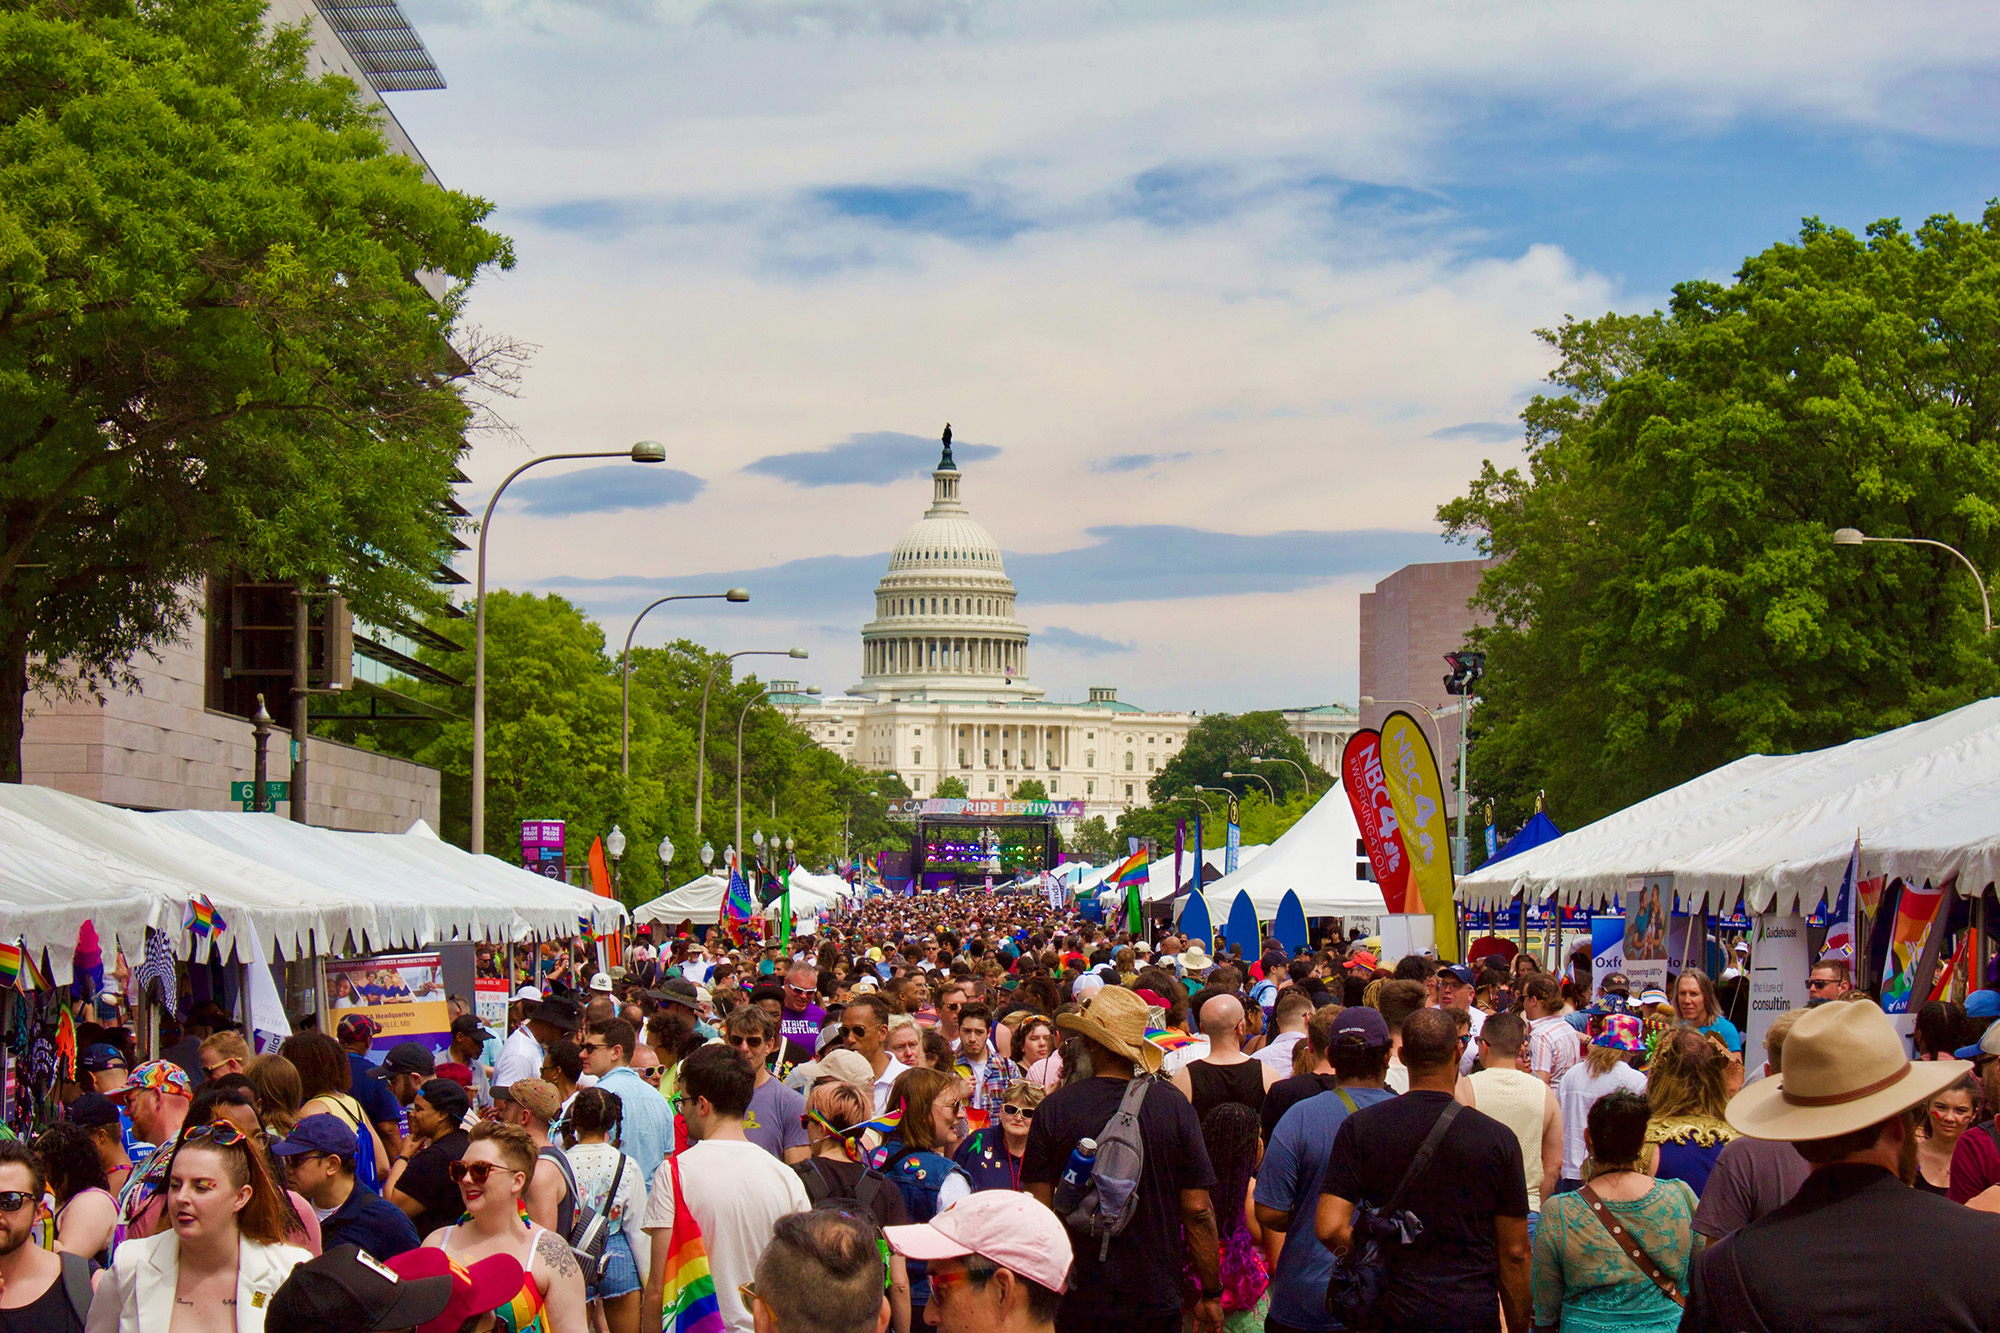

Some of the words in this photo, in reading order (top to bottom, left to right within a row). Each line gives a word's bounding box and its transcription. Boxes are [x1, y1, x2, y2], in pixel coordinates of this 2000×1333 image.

[958, 802, 998, 813] PRIDE
[1004, 802, 1065, 814] FESTIVAL
[1350, 757, 1388, 880] #WORKING4YOU
[1574, 912, 1587, 920] 44
[1766, 926, 1797, 938] Guidehouse
[1753, 997, 1790, 1010] consulting
[375, 1012, 415, 1020] Headquarters
